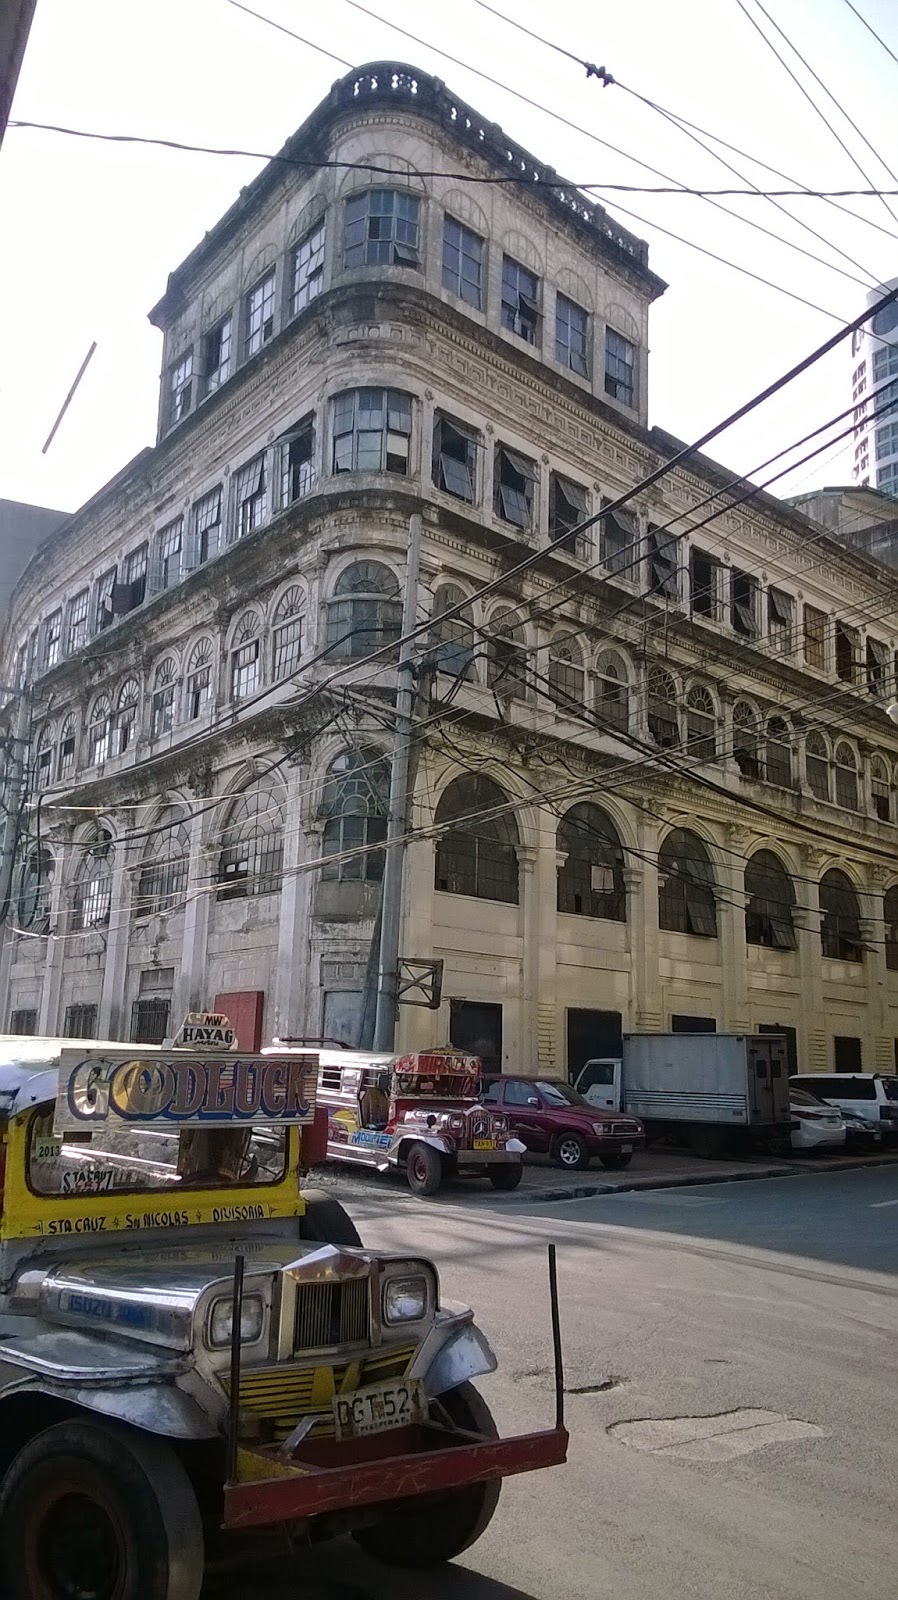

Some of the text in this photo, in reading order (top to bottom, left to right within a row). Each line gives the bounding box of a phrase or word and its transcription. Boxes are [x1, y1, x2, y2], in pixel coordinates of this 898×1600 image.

[183, 1027, 233, 1044] HAYAG
[39, 1145, 60, 1158] 2013
[48, 1220, 72, 1234] STA
[74, 1216, 107, 1233] CRUZ
[143, 1210, 189, 1228] NICOLAS
[212, 1204, 265, 1222] DIVISORIA
